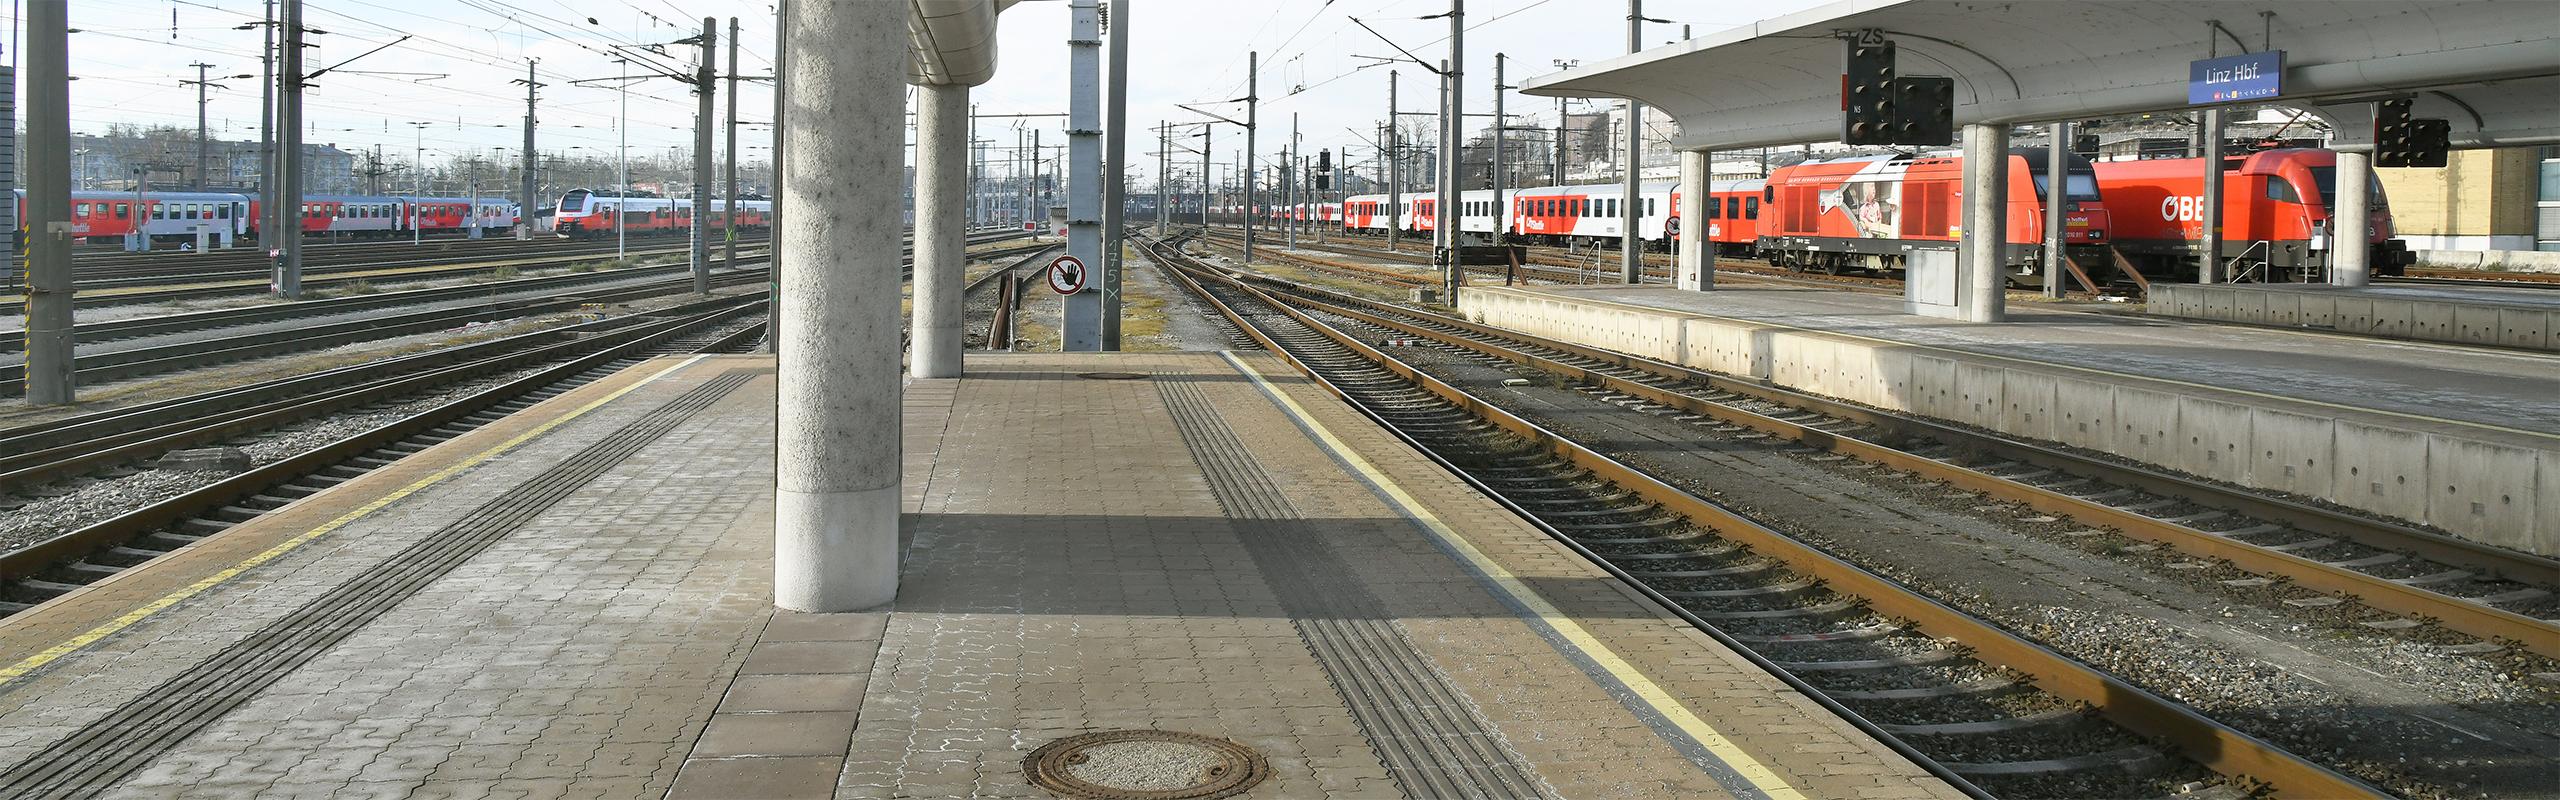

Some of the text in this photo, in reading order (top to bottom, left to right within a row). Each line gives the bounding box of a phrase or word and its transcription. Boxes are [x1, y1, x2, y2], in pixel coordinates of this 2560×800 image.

[1861, 28, 1884, 44] ZS
[2206, 62, 2260, 85] Linz Hbf.
